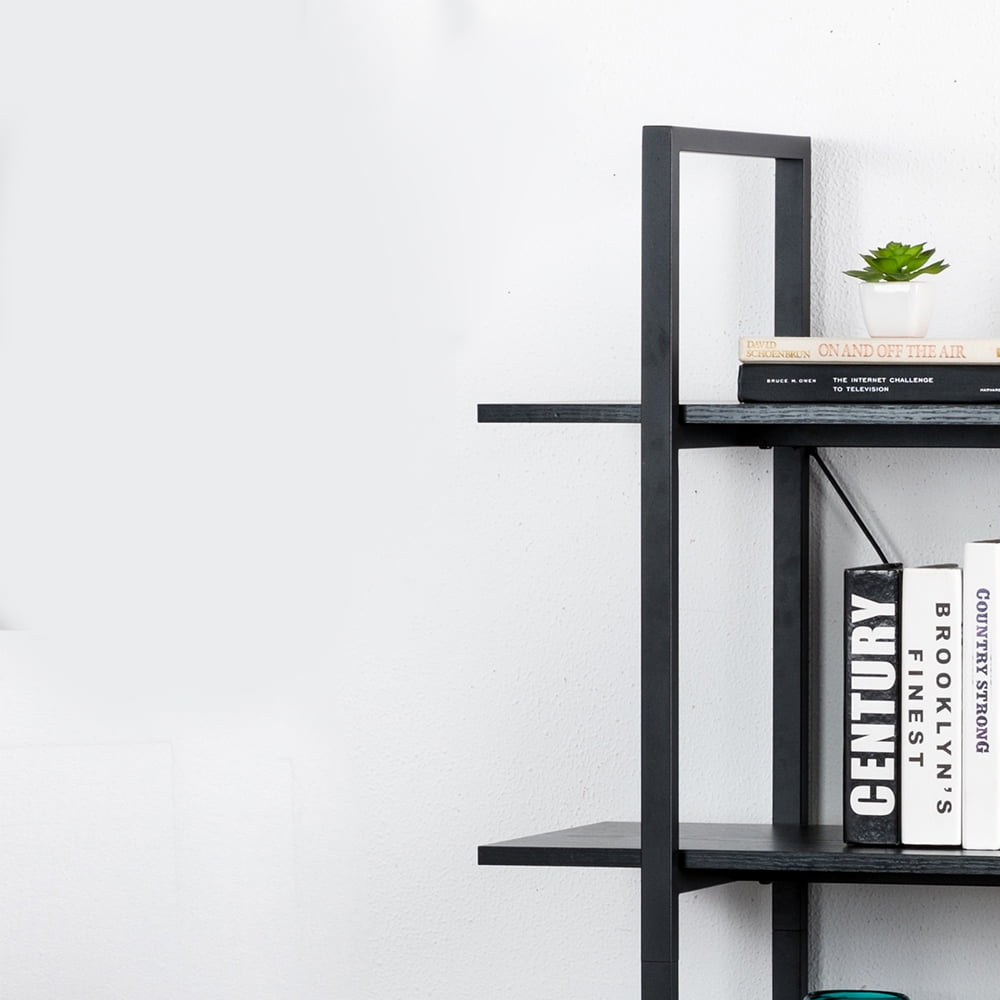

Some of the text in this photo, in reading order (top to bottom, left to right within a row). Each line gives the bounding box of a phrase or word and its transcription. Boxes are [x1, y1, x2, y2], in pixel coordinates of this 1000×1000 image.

[746, 340, 777, 349] DAVID
[817, 343, 967, 359] ON AND OFF THE AIR
[745, 349, 811, 359] SCHOENBRUN
[832, 376, 935, 384] THE INTERNET CHALLENGE
[832, 385, 890, 393] TO TELEVISION
[975, 587, 991, 754] COUNTRY STRONG
[849, 593, 897, 817] CENTURY
[907, 648, 924, 768] FINEST
